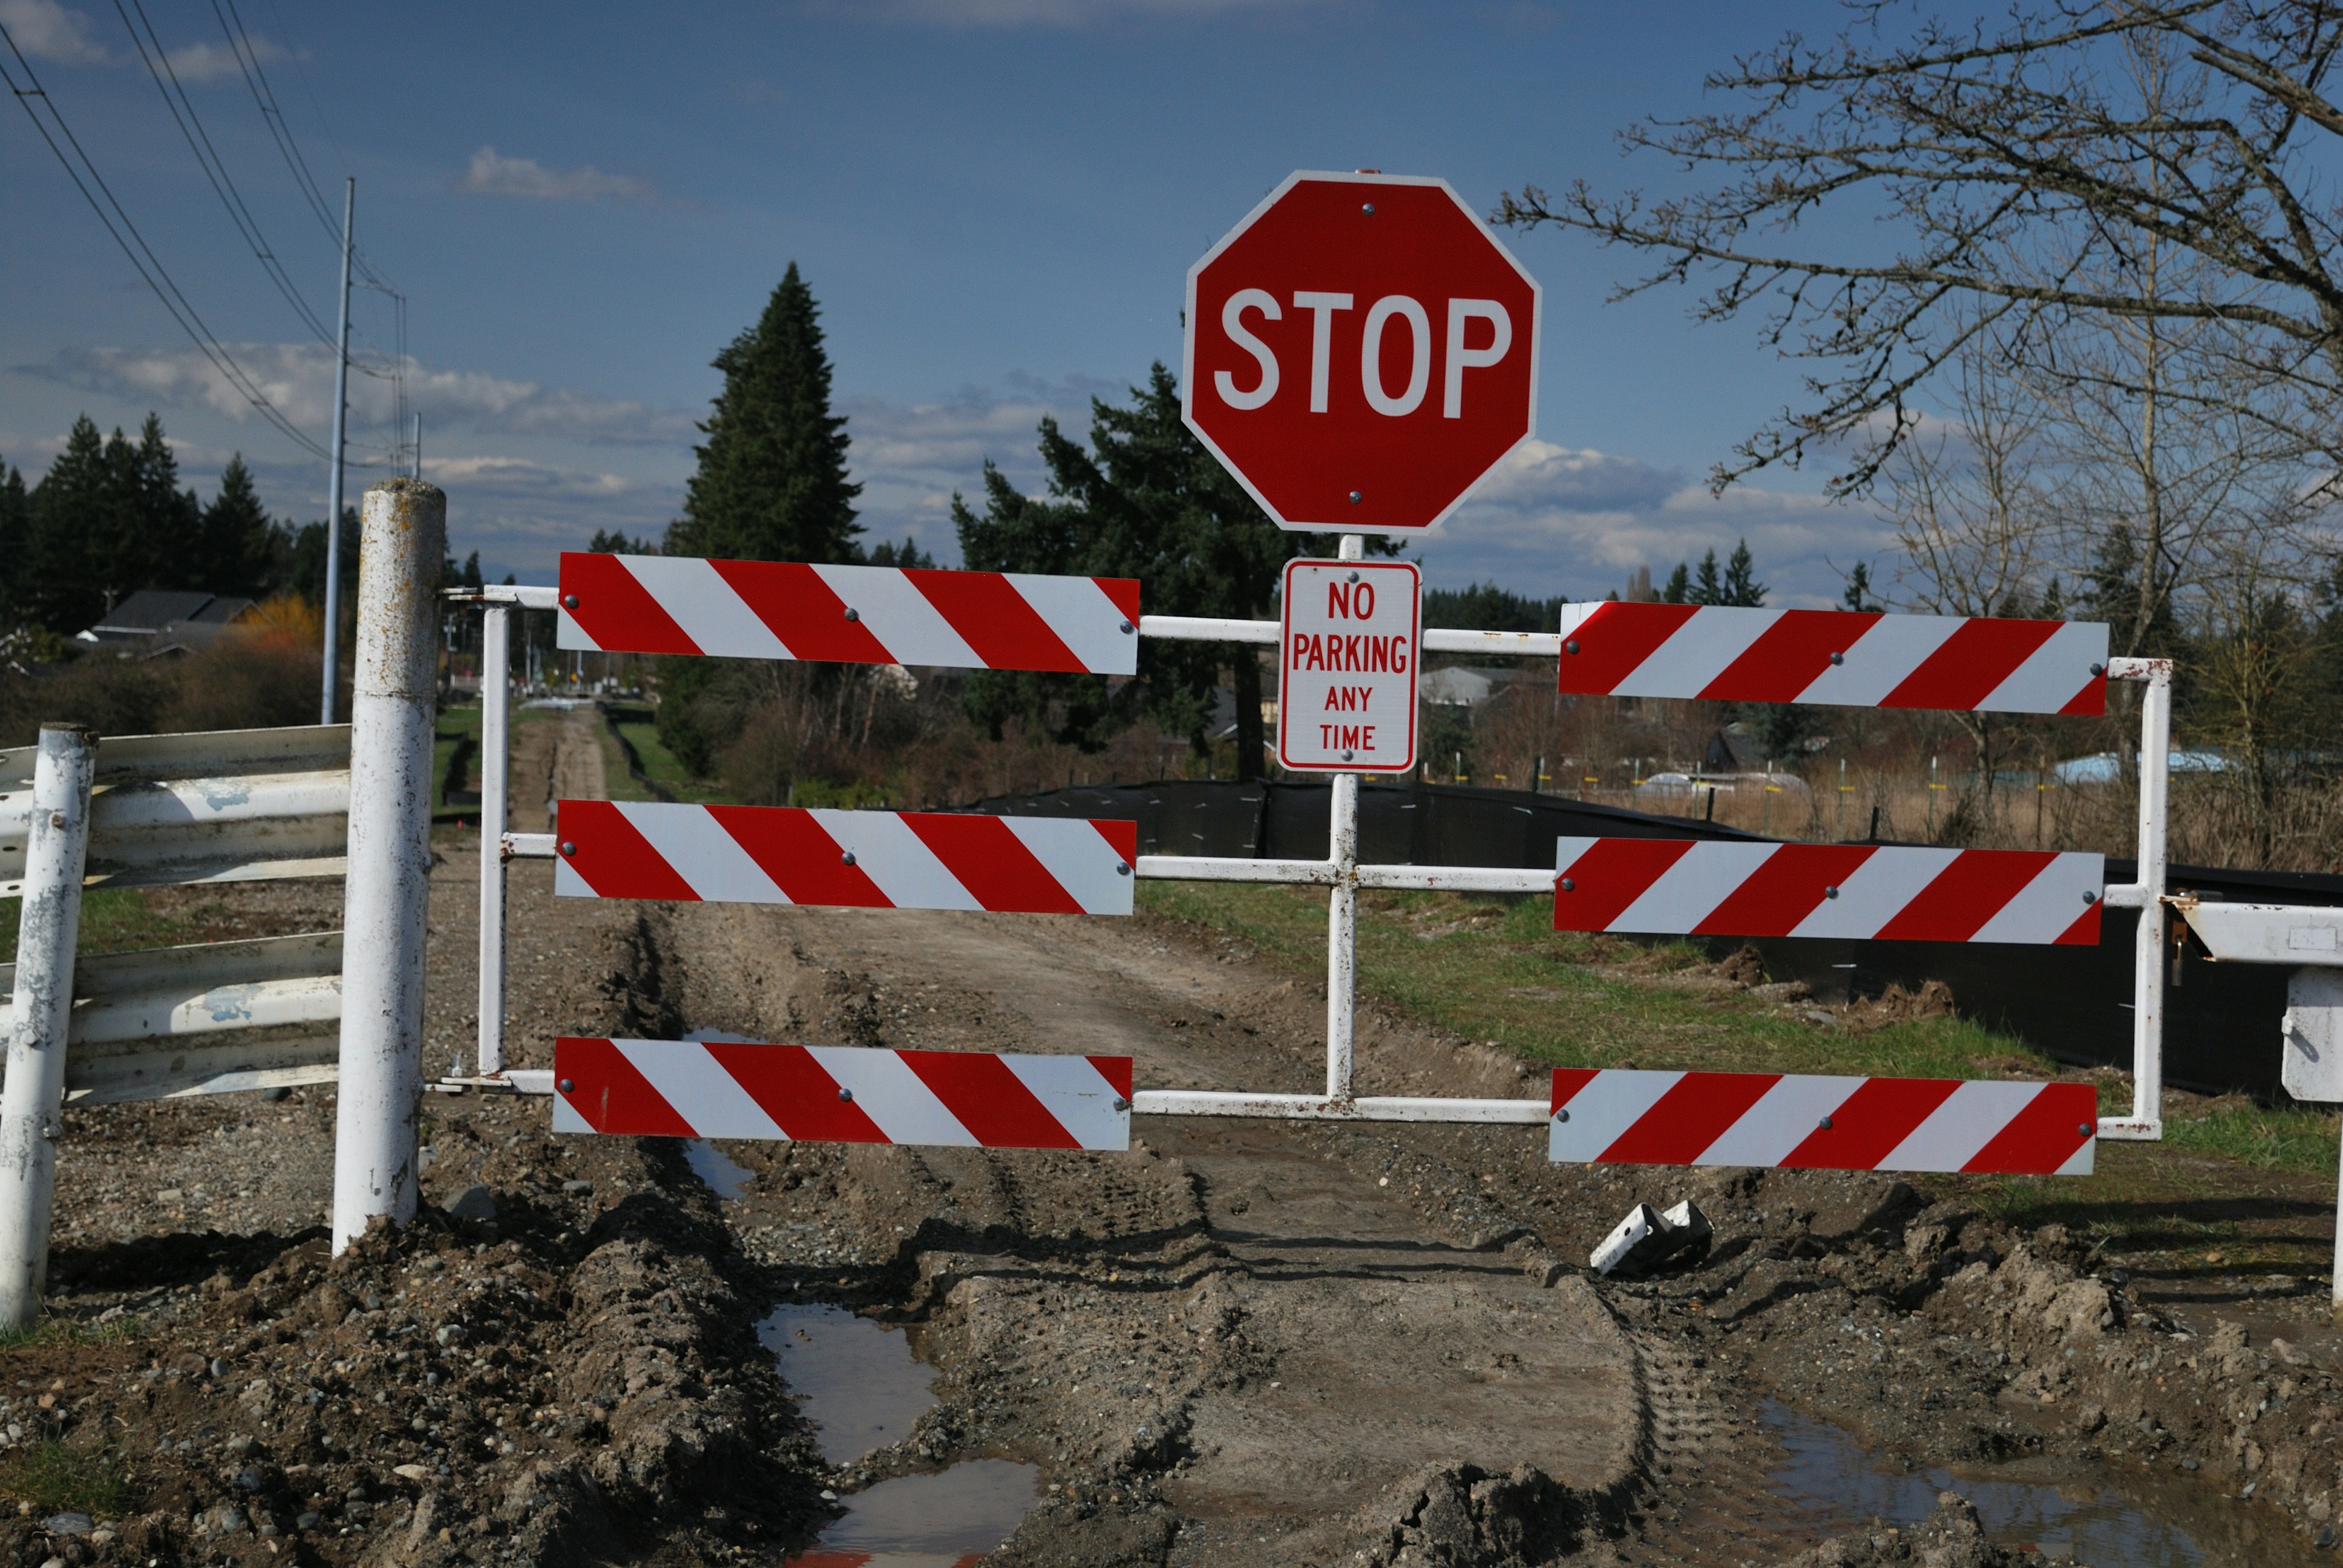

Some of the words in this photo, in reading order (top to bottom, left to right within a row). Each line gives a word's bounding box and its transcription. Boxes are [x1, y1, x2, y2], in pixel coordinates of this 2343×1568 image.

[1214, 289, 1512, 418] STOP
[1328, 582, 1374, 620] NO
[1294, 634, 1406, 673] PARKING
[1325, 687, 1372, 711] ANY
[1320, 725, 1375, 750] TIME
